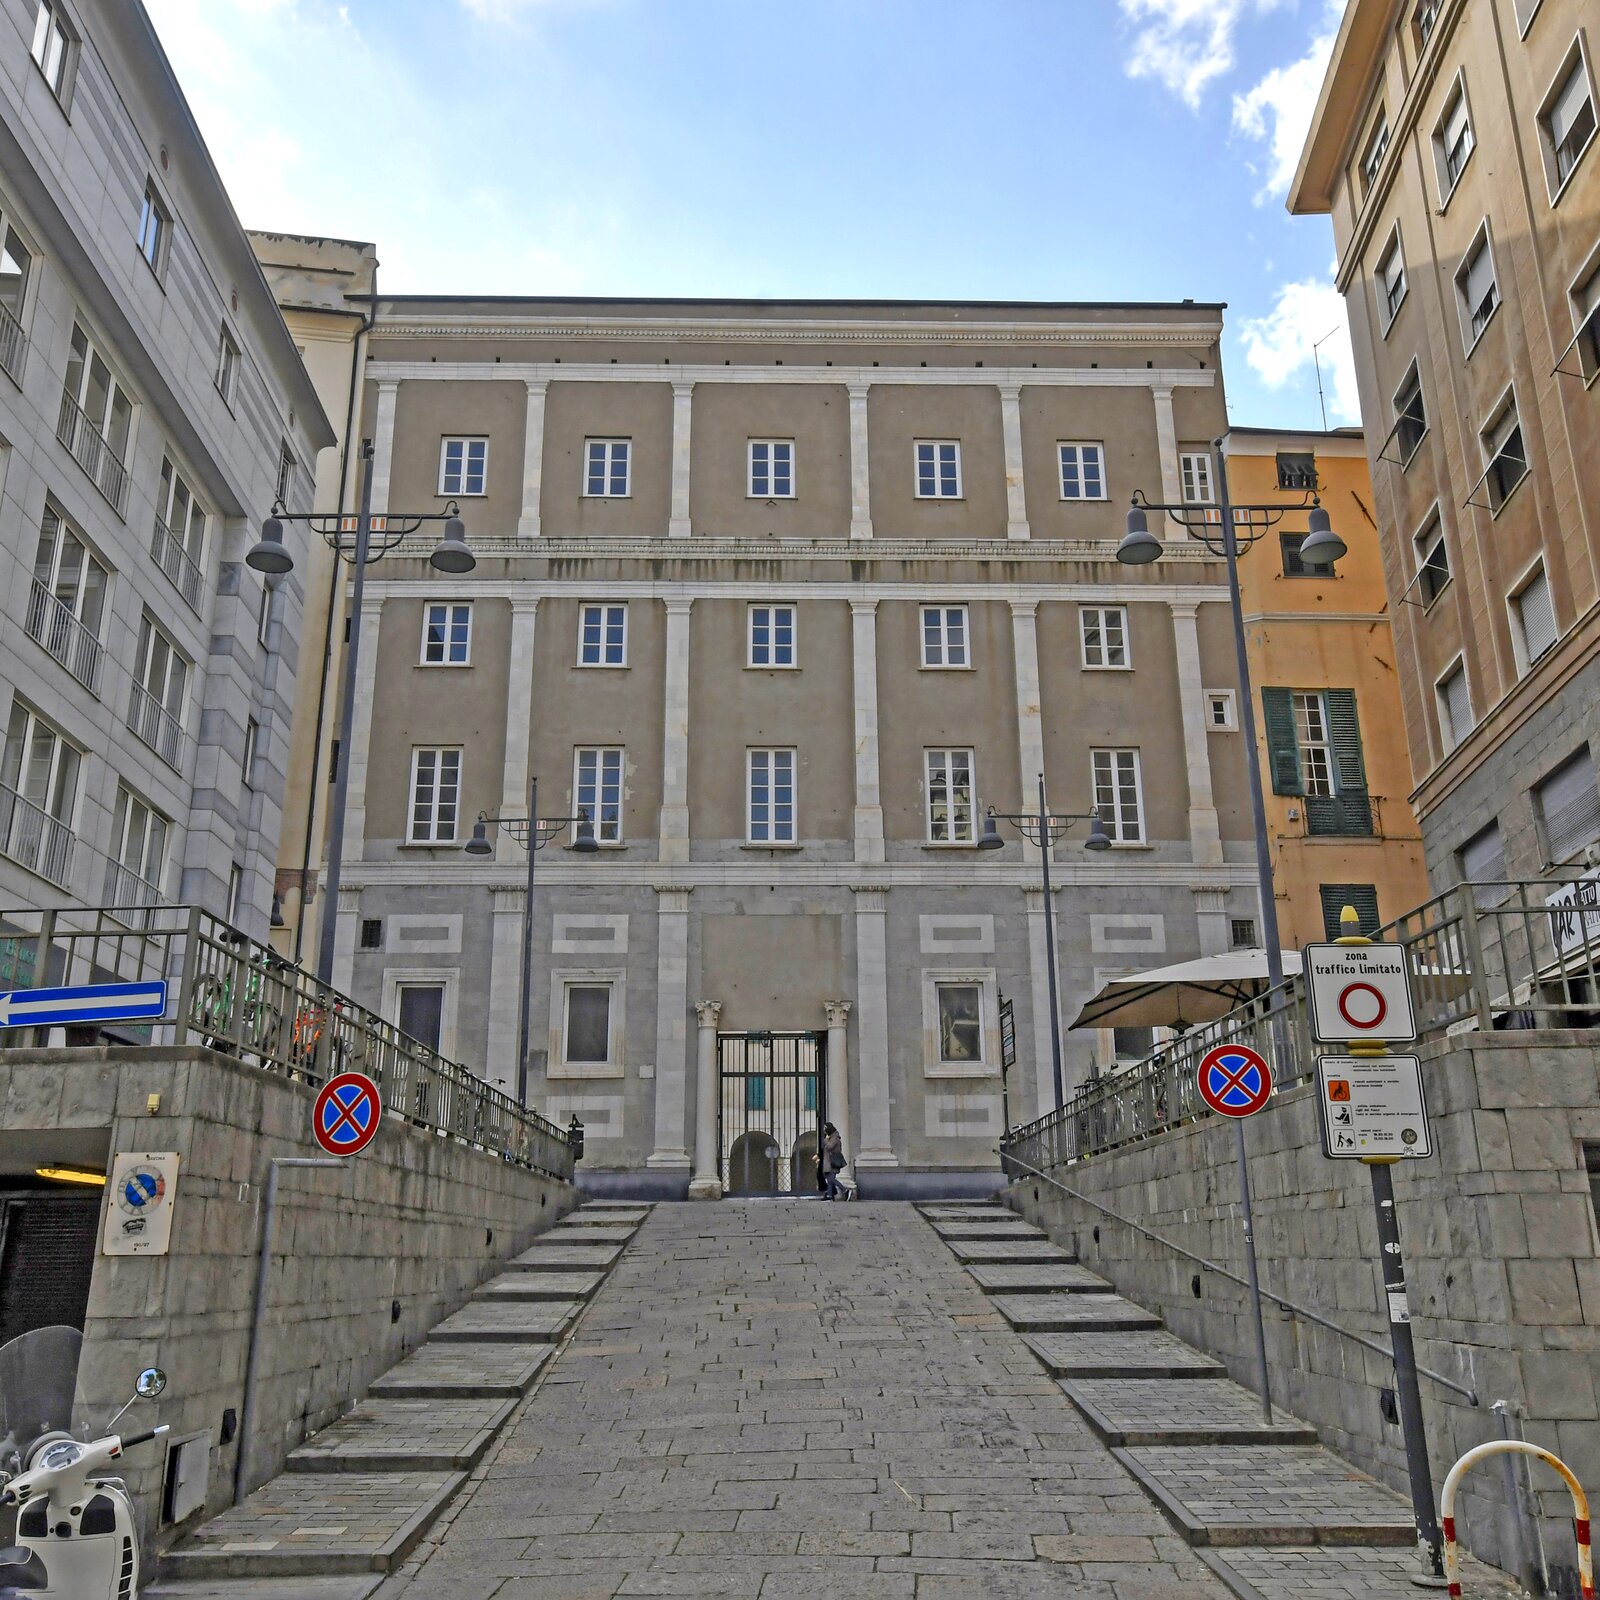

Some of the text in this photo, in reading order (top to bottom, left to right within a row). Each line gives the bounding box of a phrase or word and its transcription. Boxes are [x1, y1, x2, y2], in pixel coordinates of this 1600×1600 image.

[1345, 952, 1368, 961] zona
[1315, 963, 1401, 975] traffico limitato
